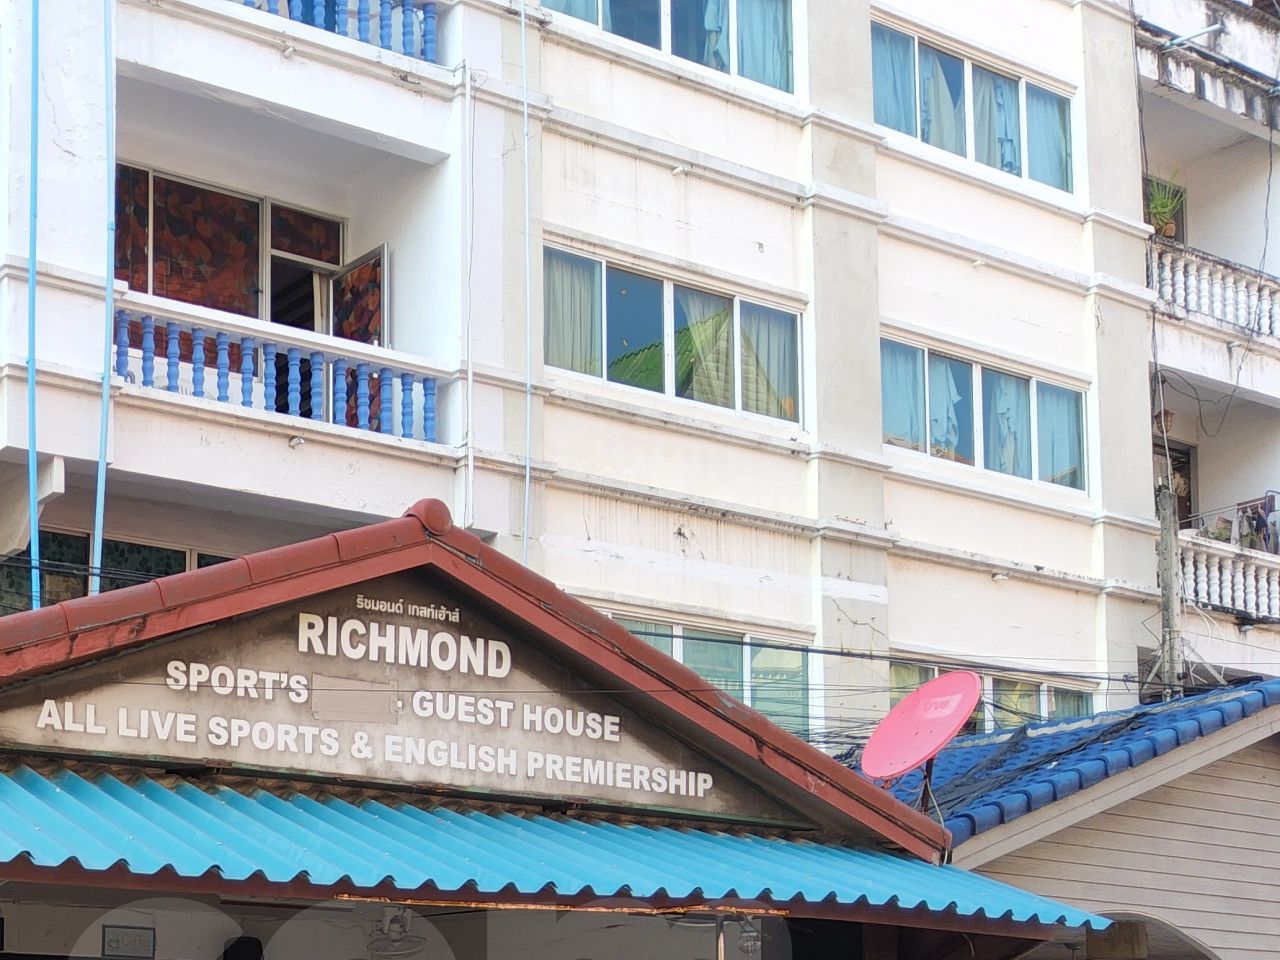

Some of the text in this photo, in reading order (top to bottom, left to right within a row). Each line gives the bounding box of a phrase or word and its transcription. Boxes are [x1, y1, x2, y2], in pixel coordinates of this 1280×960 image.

[356, 594, 460, 623] ริชมอนด์ เกสท์เฮ้าส์
[297, 612, 513, 680] RICHMOND
[166, 660, 310, 704] SPORT'S
[412, 690, 622, 743] GUEST HOUSE
[36, 699, 715, 799] ALL LIVE SPORTS & ENGLISH PREMIERSHIP
